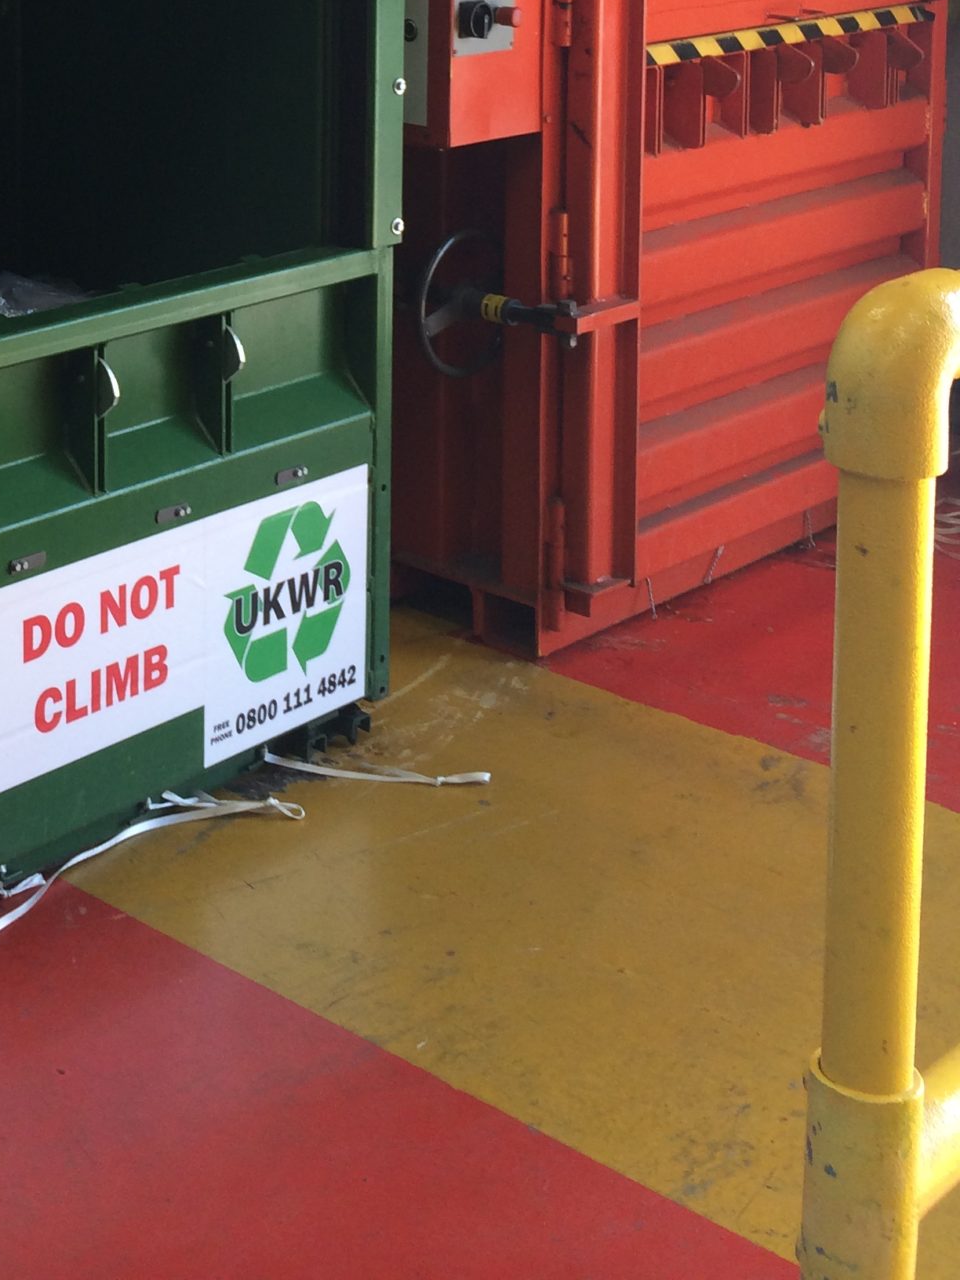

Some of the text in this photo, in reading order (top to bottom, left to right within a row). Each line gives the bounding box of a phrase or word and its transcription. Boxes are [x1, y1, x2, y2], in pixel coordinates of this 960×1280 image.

[23, 564, 180, 664] DO NOT
[234, 560, 343, 635] UKWR
[34, 644, 169, 734] CLIMB
[235, 665, 357, 735] 0800 111 4842
[210, 730, 233, 746] PHONE
[213, 720, 230, 733] FREE
